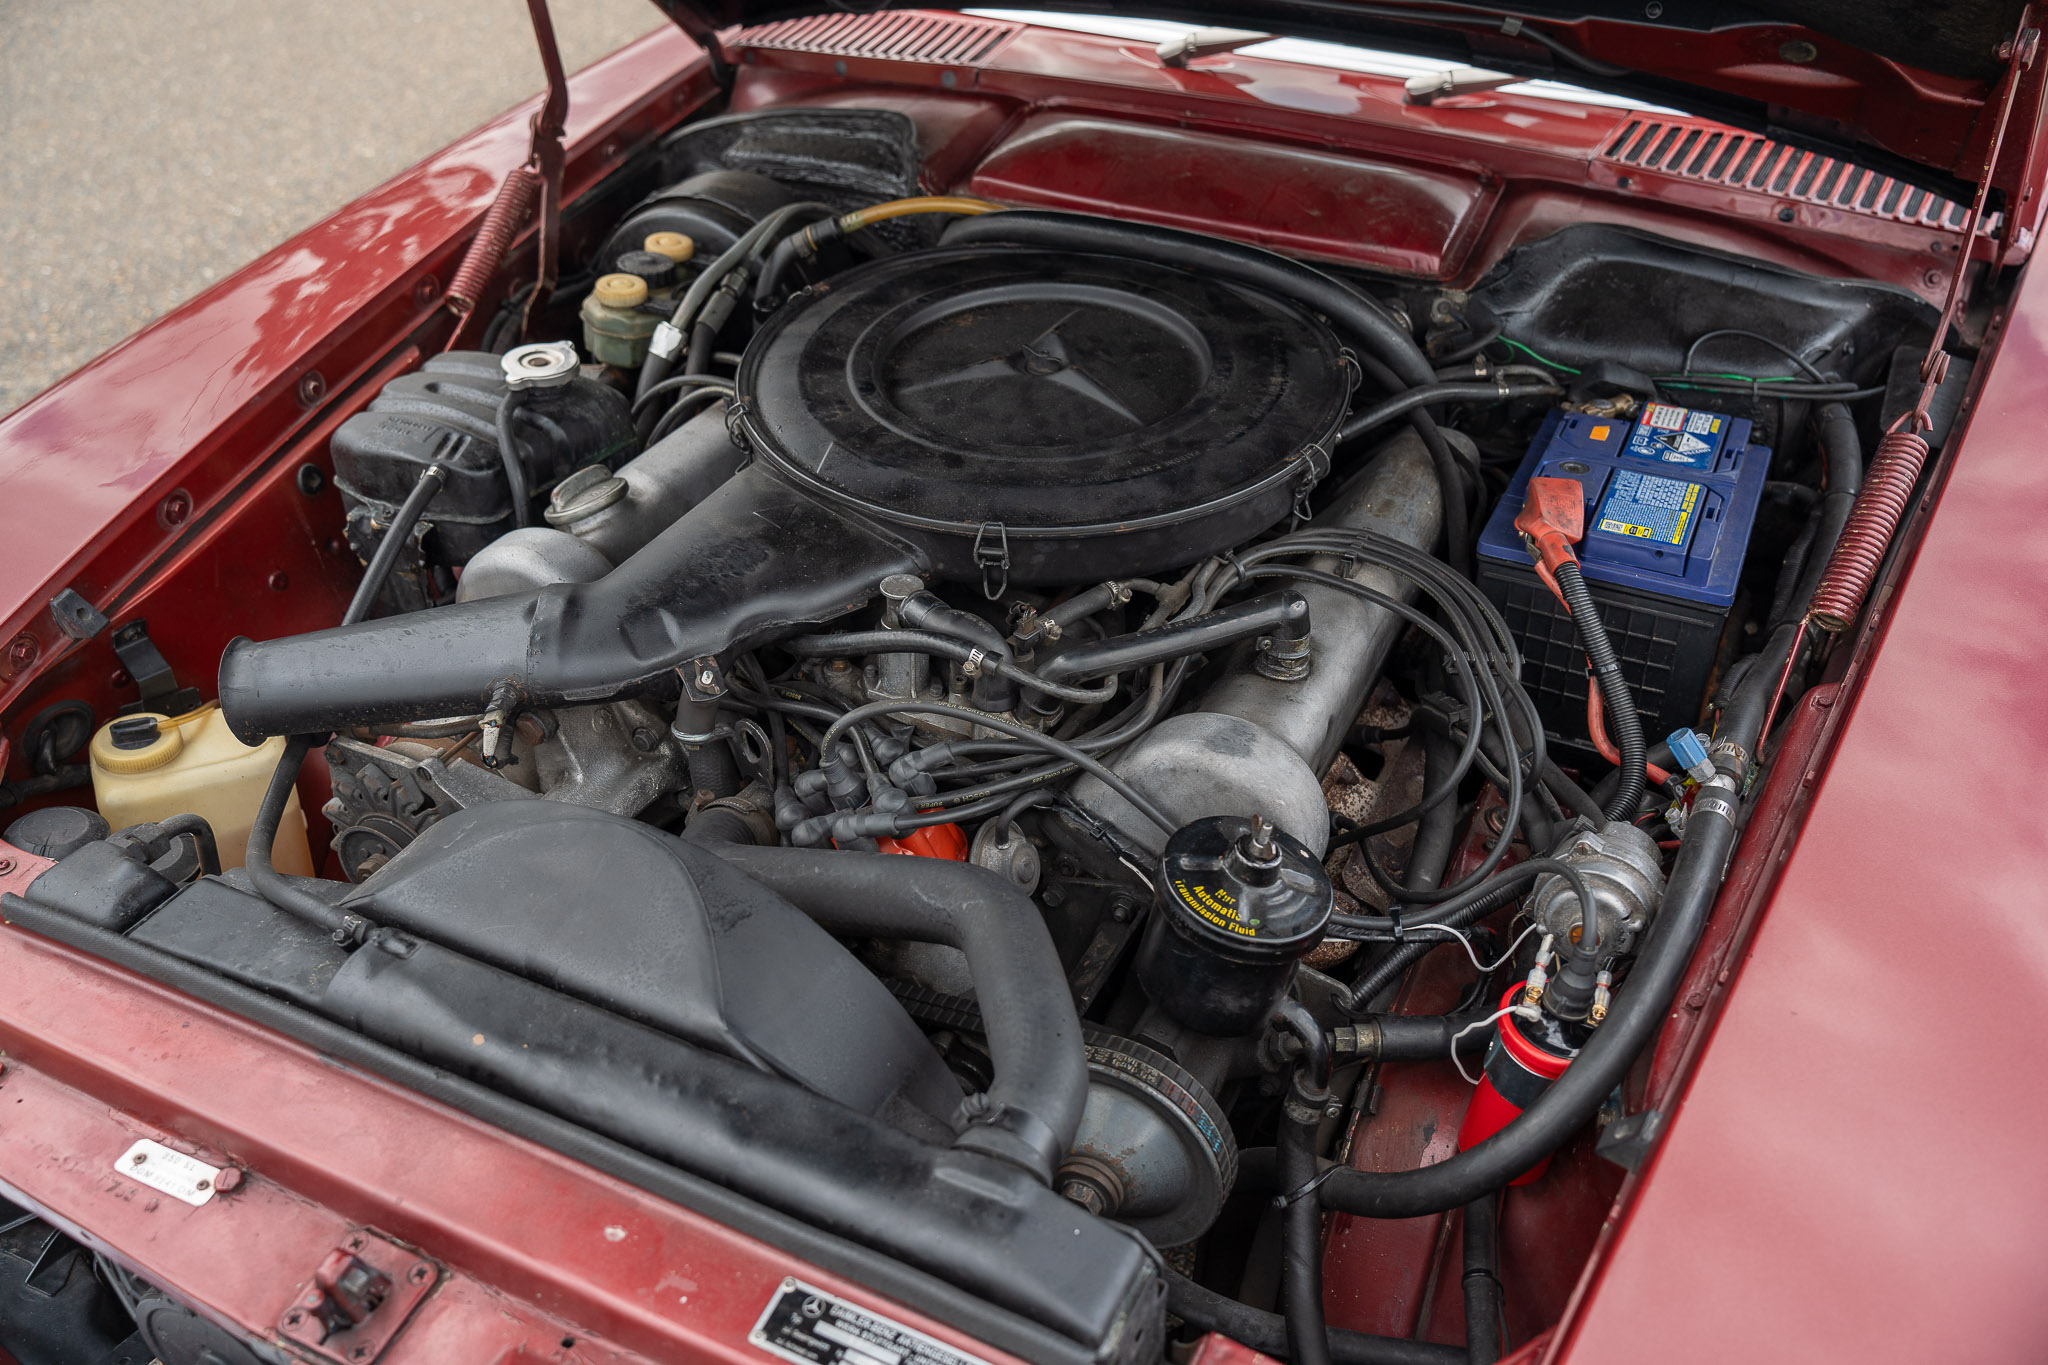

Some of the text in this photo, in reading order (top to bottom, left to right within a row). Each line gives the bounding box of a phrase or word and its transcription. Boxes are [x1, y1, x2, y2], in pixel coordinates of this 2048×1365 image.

[1193, 885, 1243, 921] Automatic
[1214, 888, 1237, 906] Nur
[1228, 922, 1256, 937] Fluid
